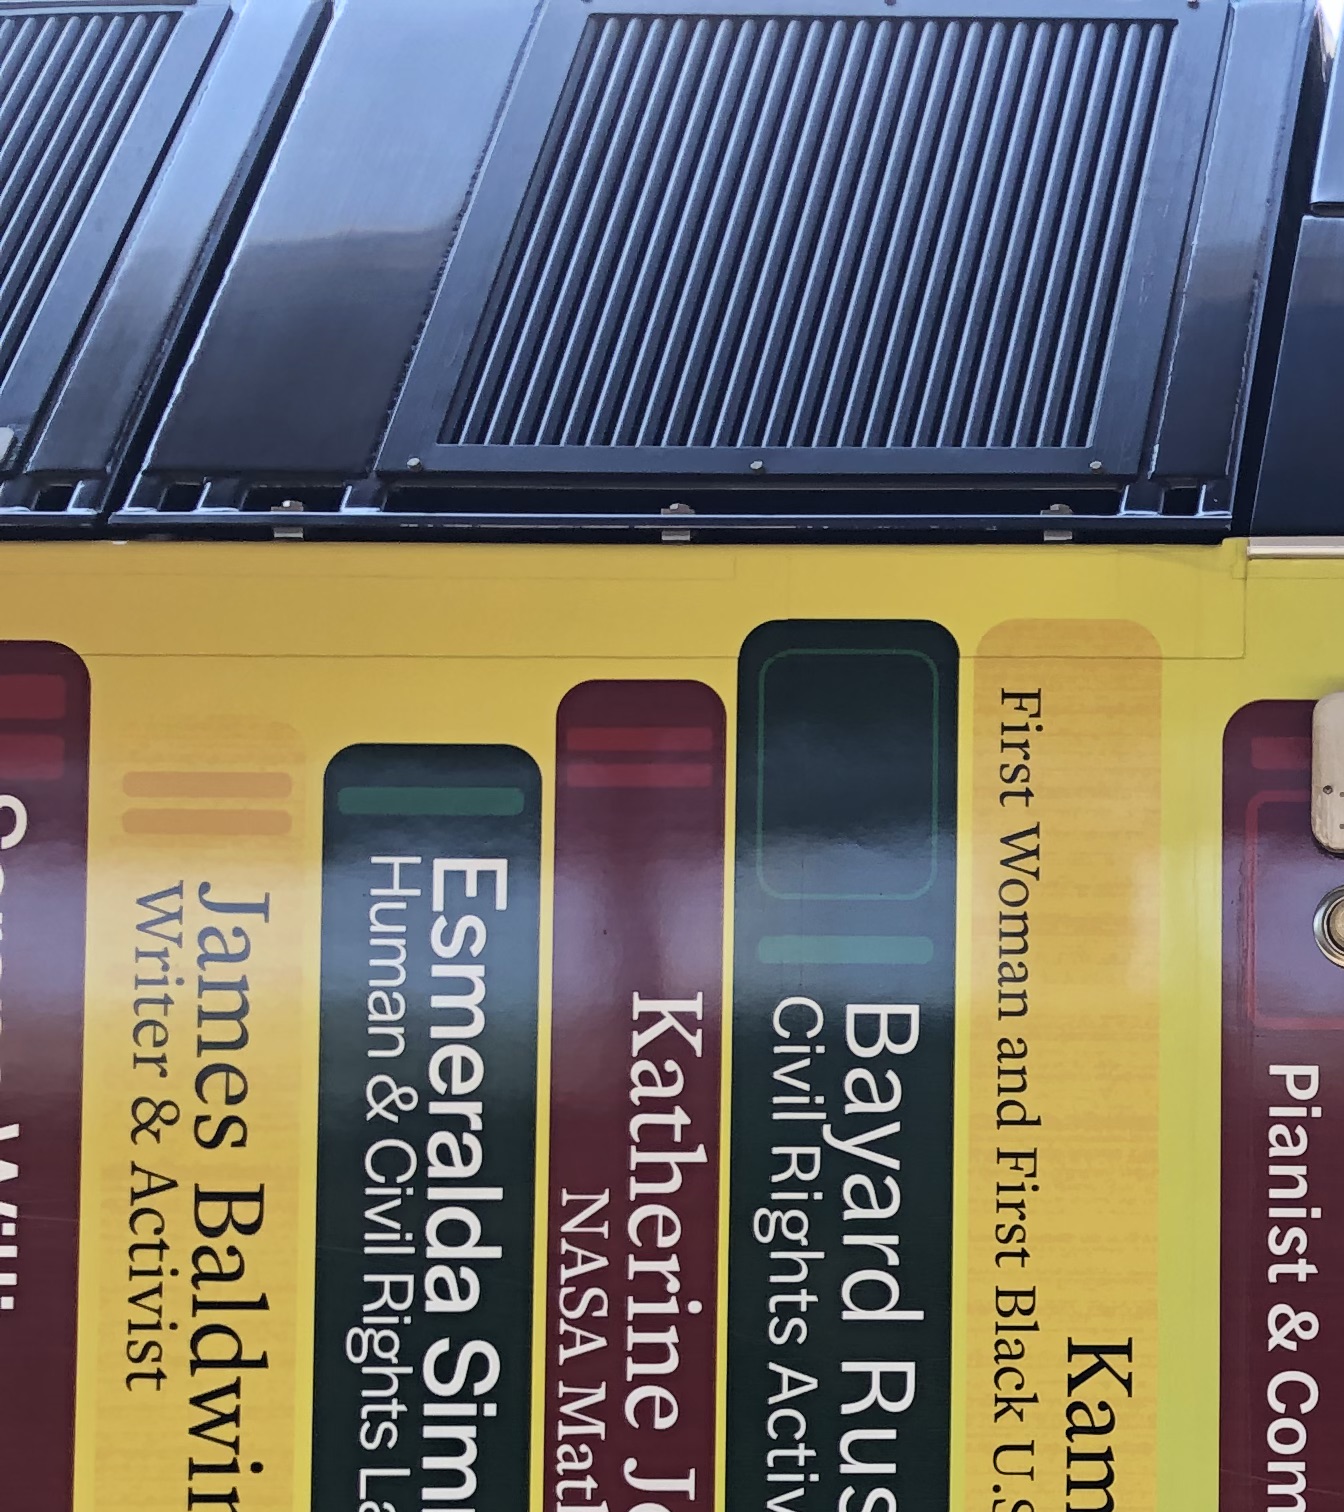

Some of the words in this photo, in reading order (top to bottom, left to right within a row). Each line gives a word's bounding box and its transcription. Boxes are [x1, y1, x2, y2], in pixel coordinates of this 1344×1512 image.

[999, 687, 1044, 808] First
[132, 879, 185, 1079] Writer
[367, 856, 422, 1058] Human
[997, 821, 1041, 1021] Woman
[193, 881, 270, 1150] James
[365, 1074, 419, 1123] &
[424, 857, 509, 1313] Esmeralda
[772, 996, 827, 1120] Civil
[996, 1037, 1042, 1131] and
[130, 1096, 181, 1146] &
[363, 1138, 418, 1255] Civil
[624, 991, 708, 1430] Katherine
[822, 1003, 925, 1321] Bayard
[994, 1146, 1040, 1268] First
[1267, 1064, 1322, 1283] Pianist
[125, 1160, 180, 1392] Activist
[558, 1187, 610, 1366] NASA
[753, 1146, 825, 1345] Rights
[1267, 1303, 1320, 1352] &
[345, 1274, 415, 1450] Rights
[993, 1285, 1040, 1423] Black
